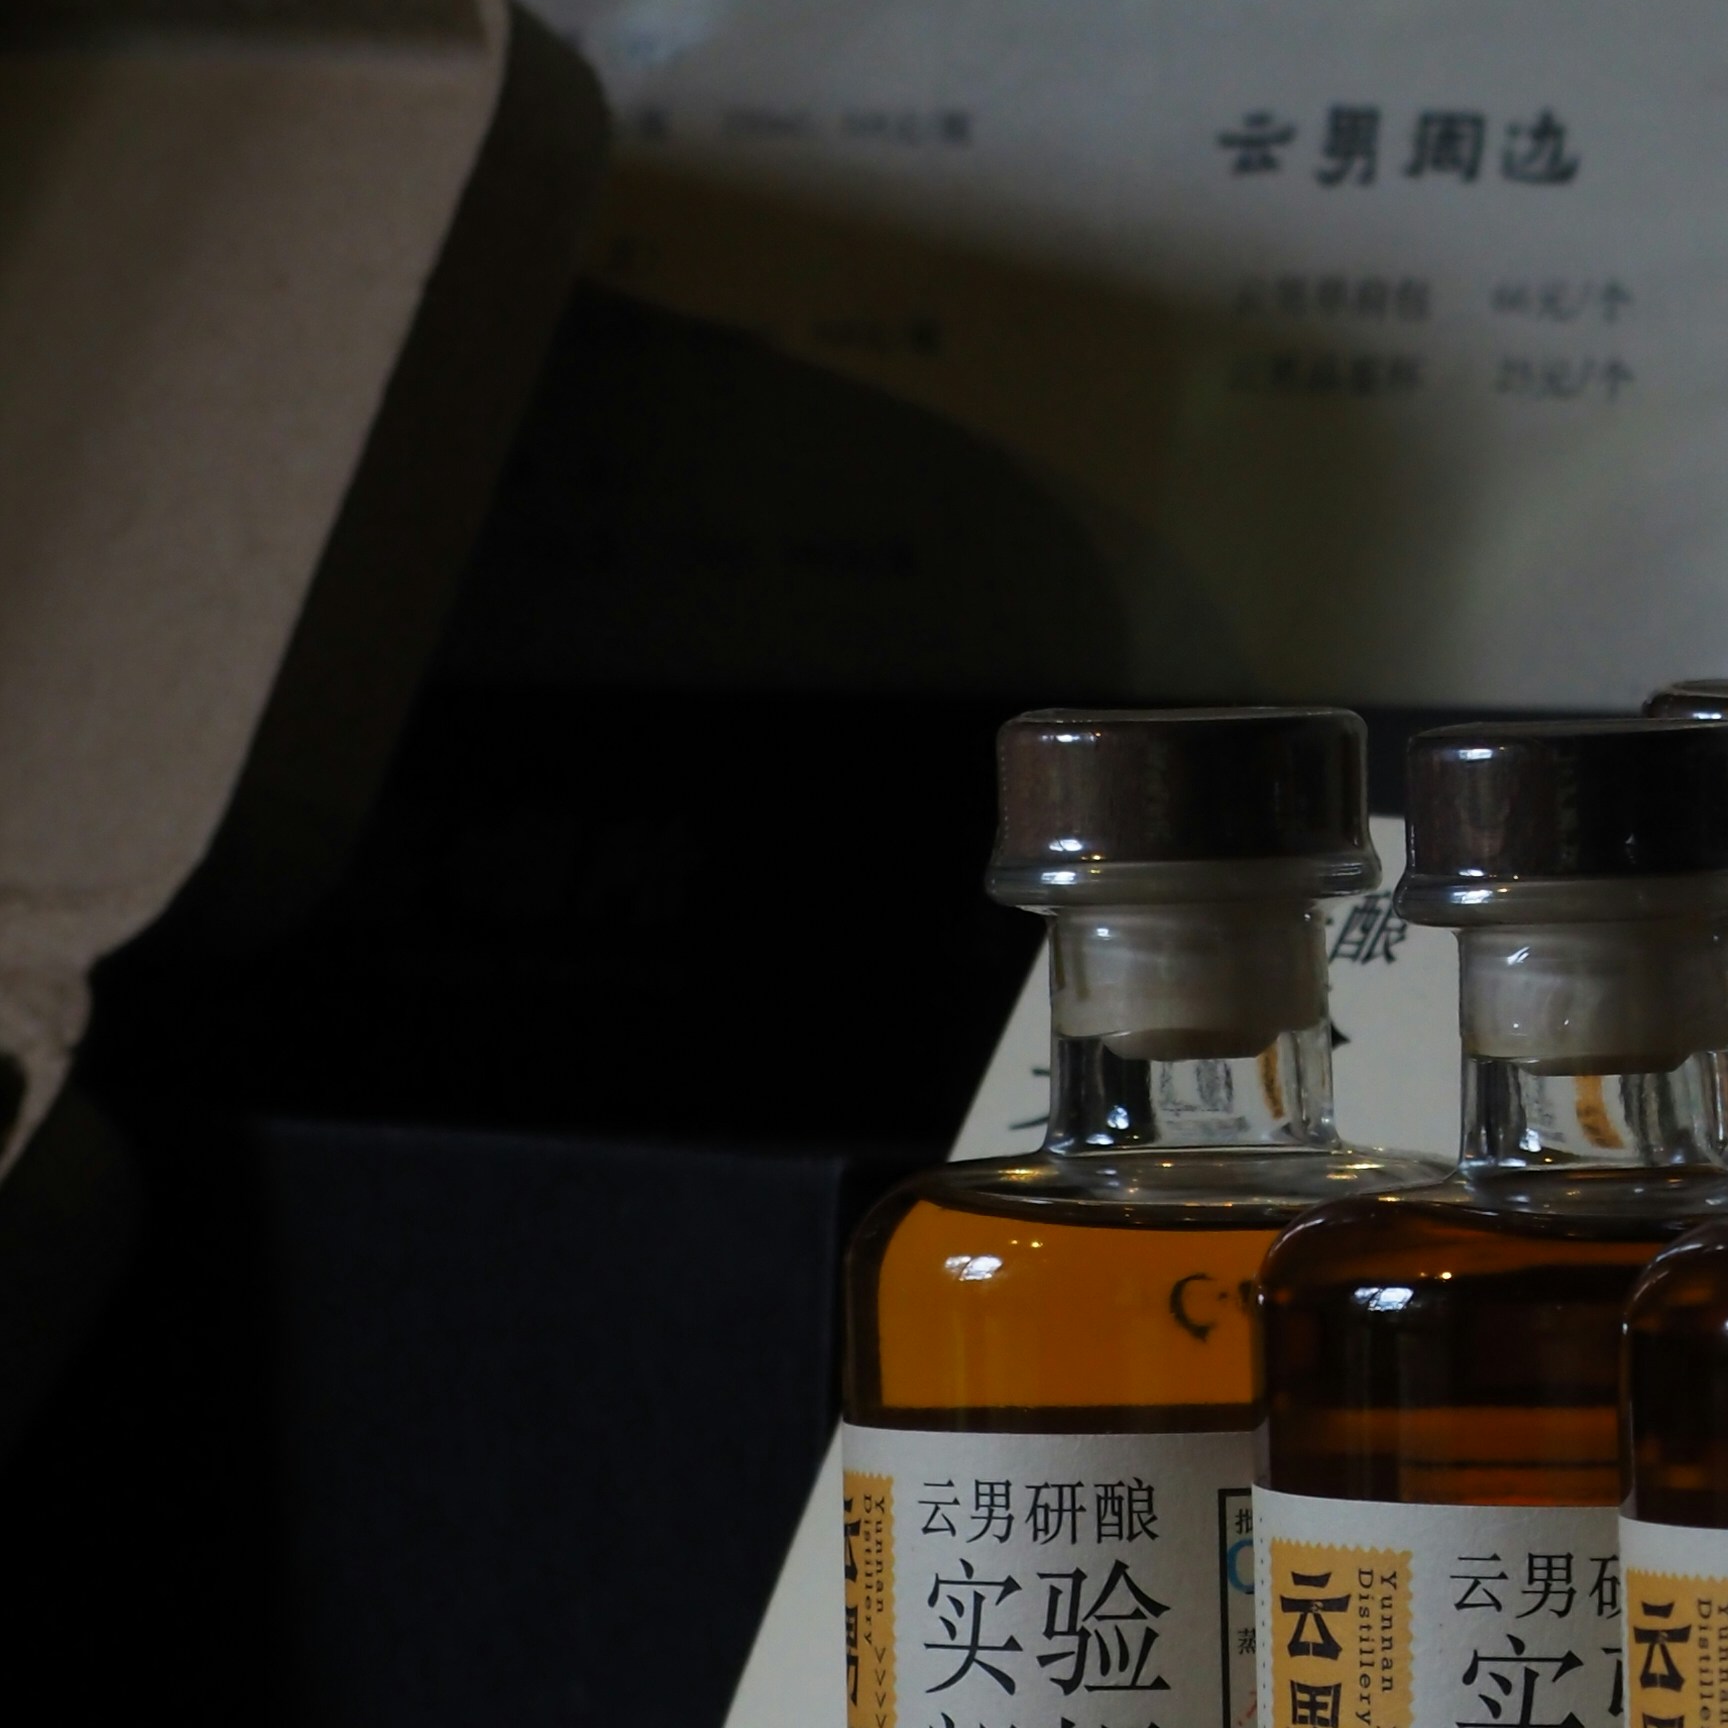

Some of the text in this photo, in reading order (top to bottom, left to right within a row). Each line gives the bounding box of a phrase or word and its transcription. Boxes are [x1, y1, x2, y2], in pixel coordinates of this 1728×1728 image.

[1216, 104, 1579, 186] 云男周边
[917, 1476, 1160, 1545] 云男研酿
[923, 1557, 1171, 1696] 实验
[1356, 1568, 1375, 1726] Distillery
[1380, 1570, 1398, 1693] Yunnan
